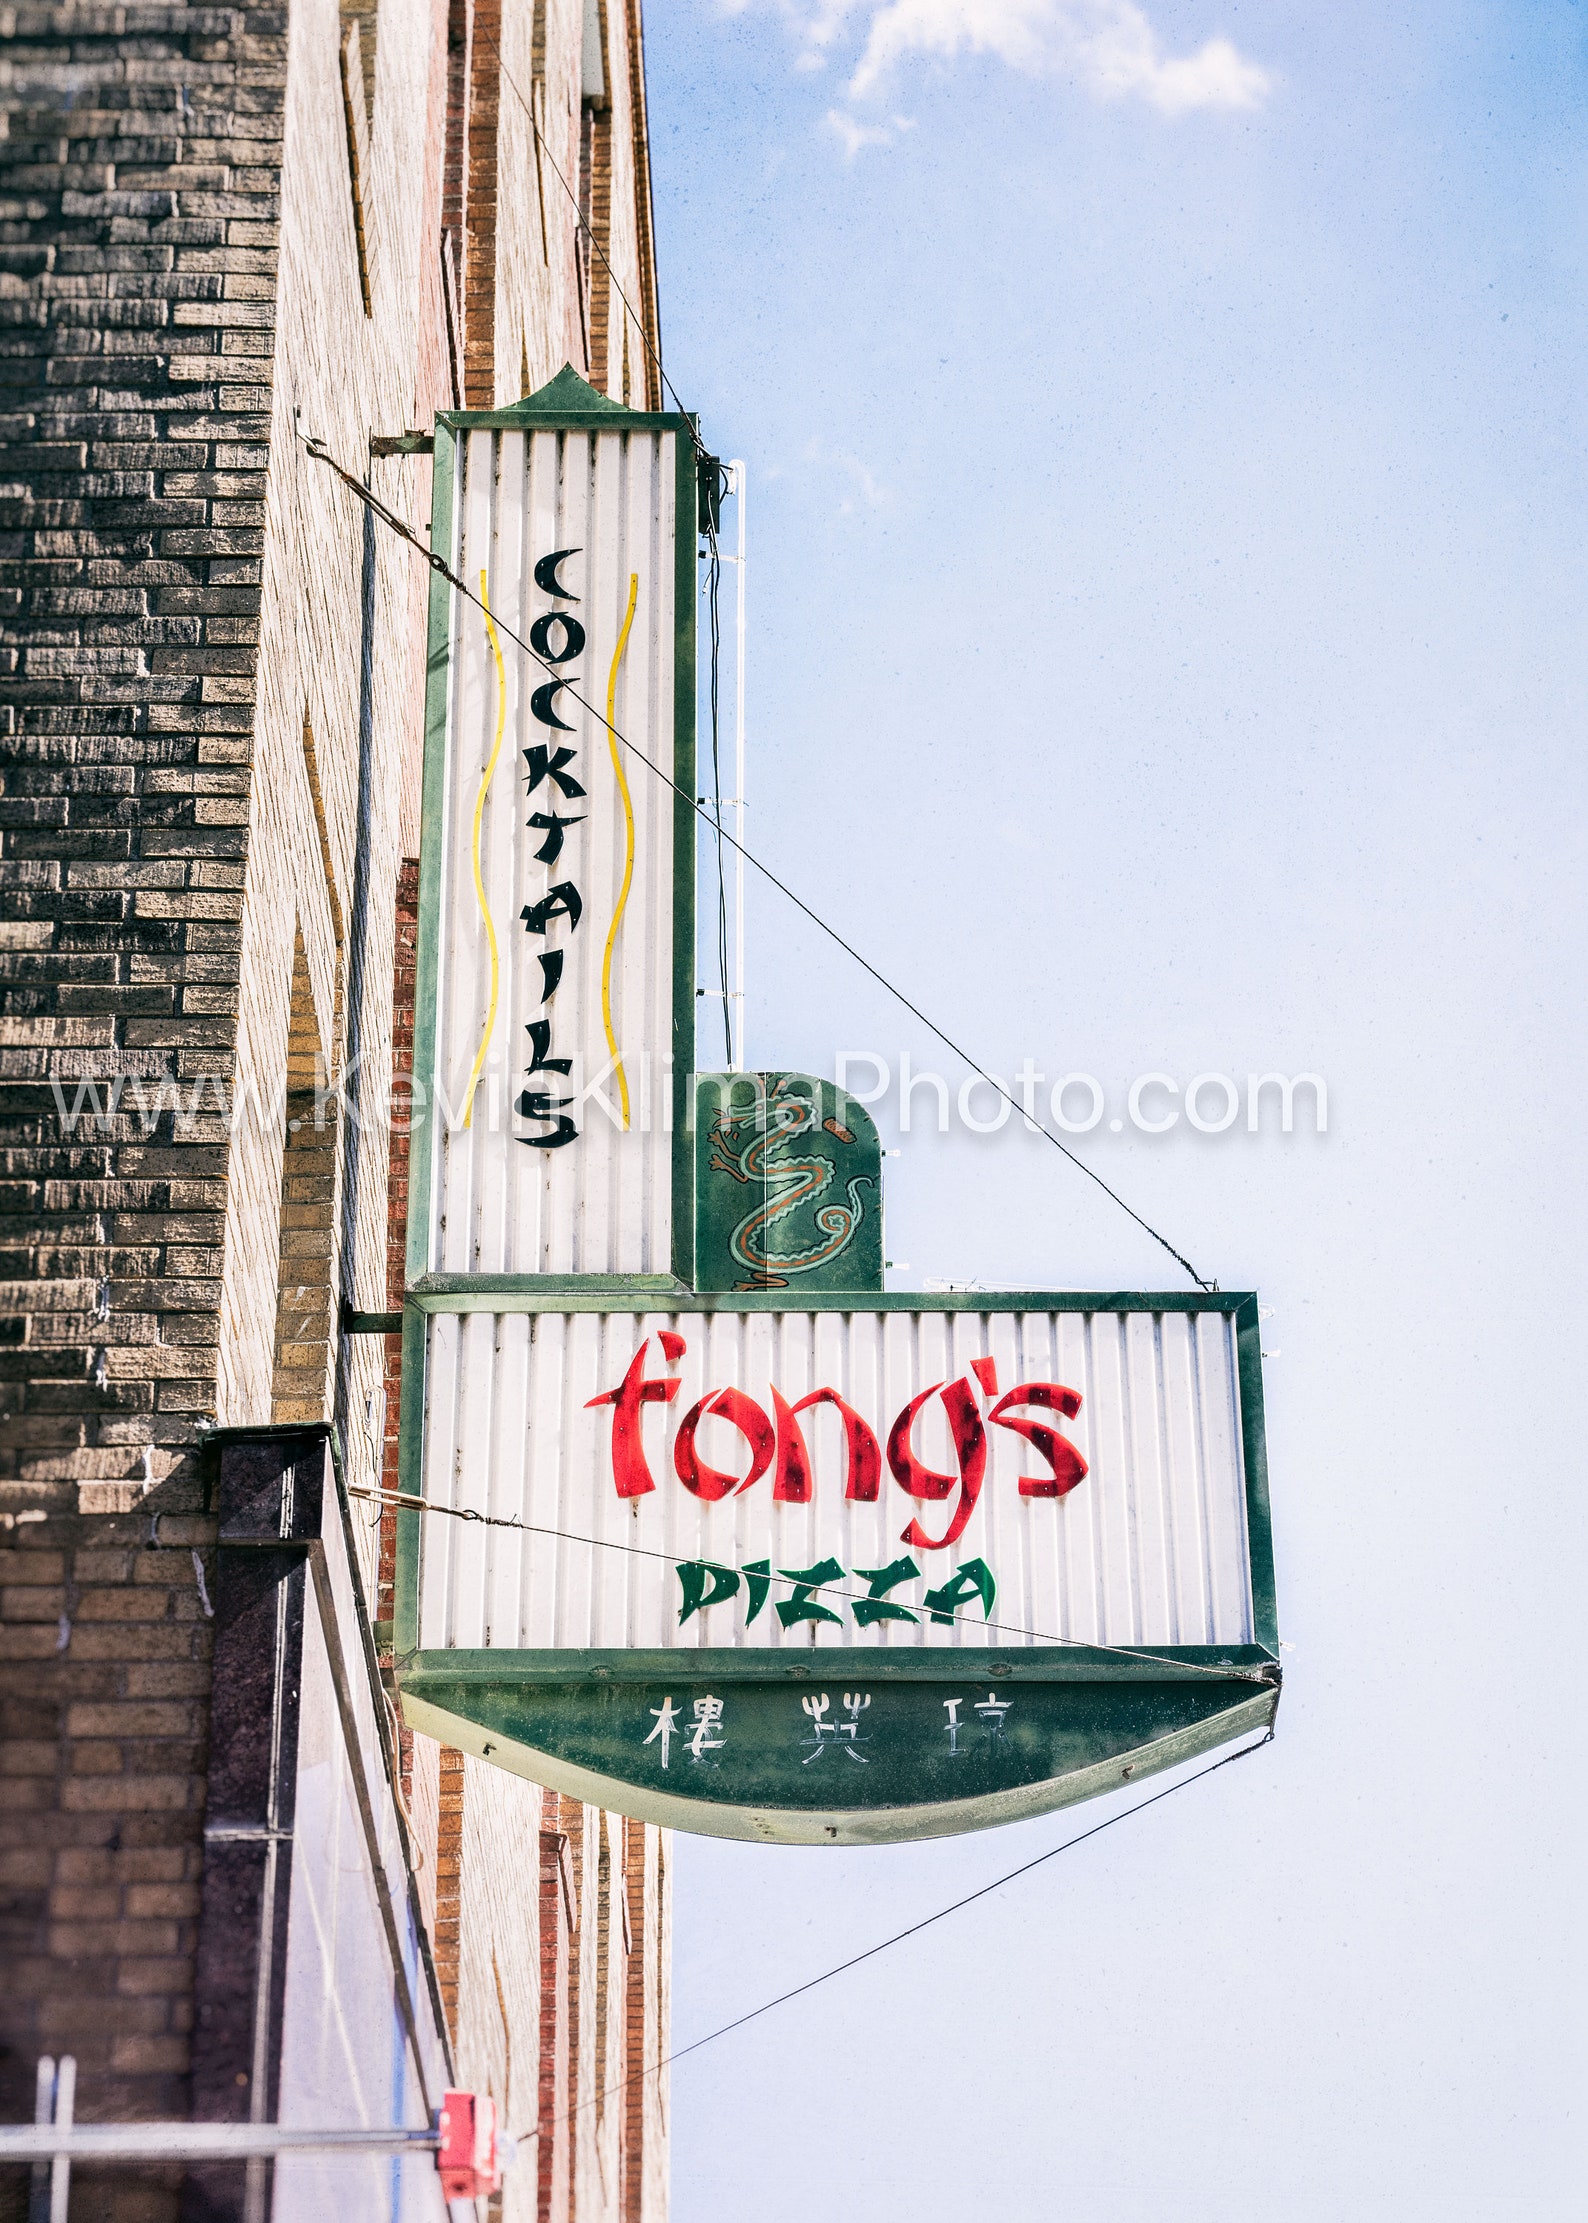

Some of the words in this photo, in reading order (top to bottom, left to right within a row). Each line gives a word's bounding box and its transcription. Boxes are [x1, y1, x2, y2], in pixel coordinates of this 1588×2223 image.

[514, 548, 587, 1148] COCKTAILS
[583, 1330, 1089, 1551] fong's
[675, 1557, 998, 1628] PIZZA
